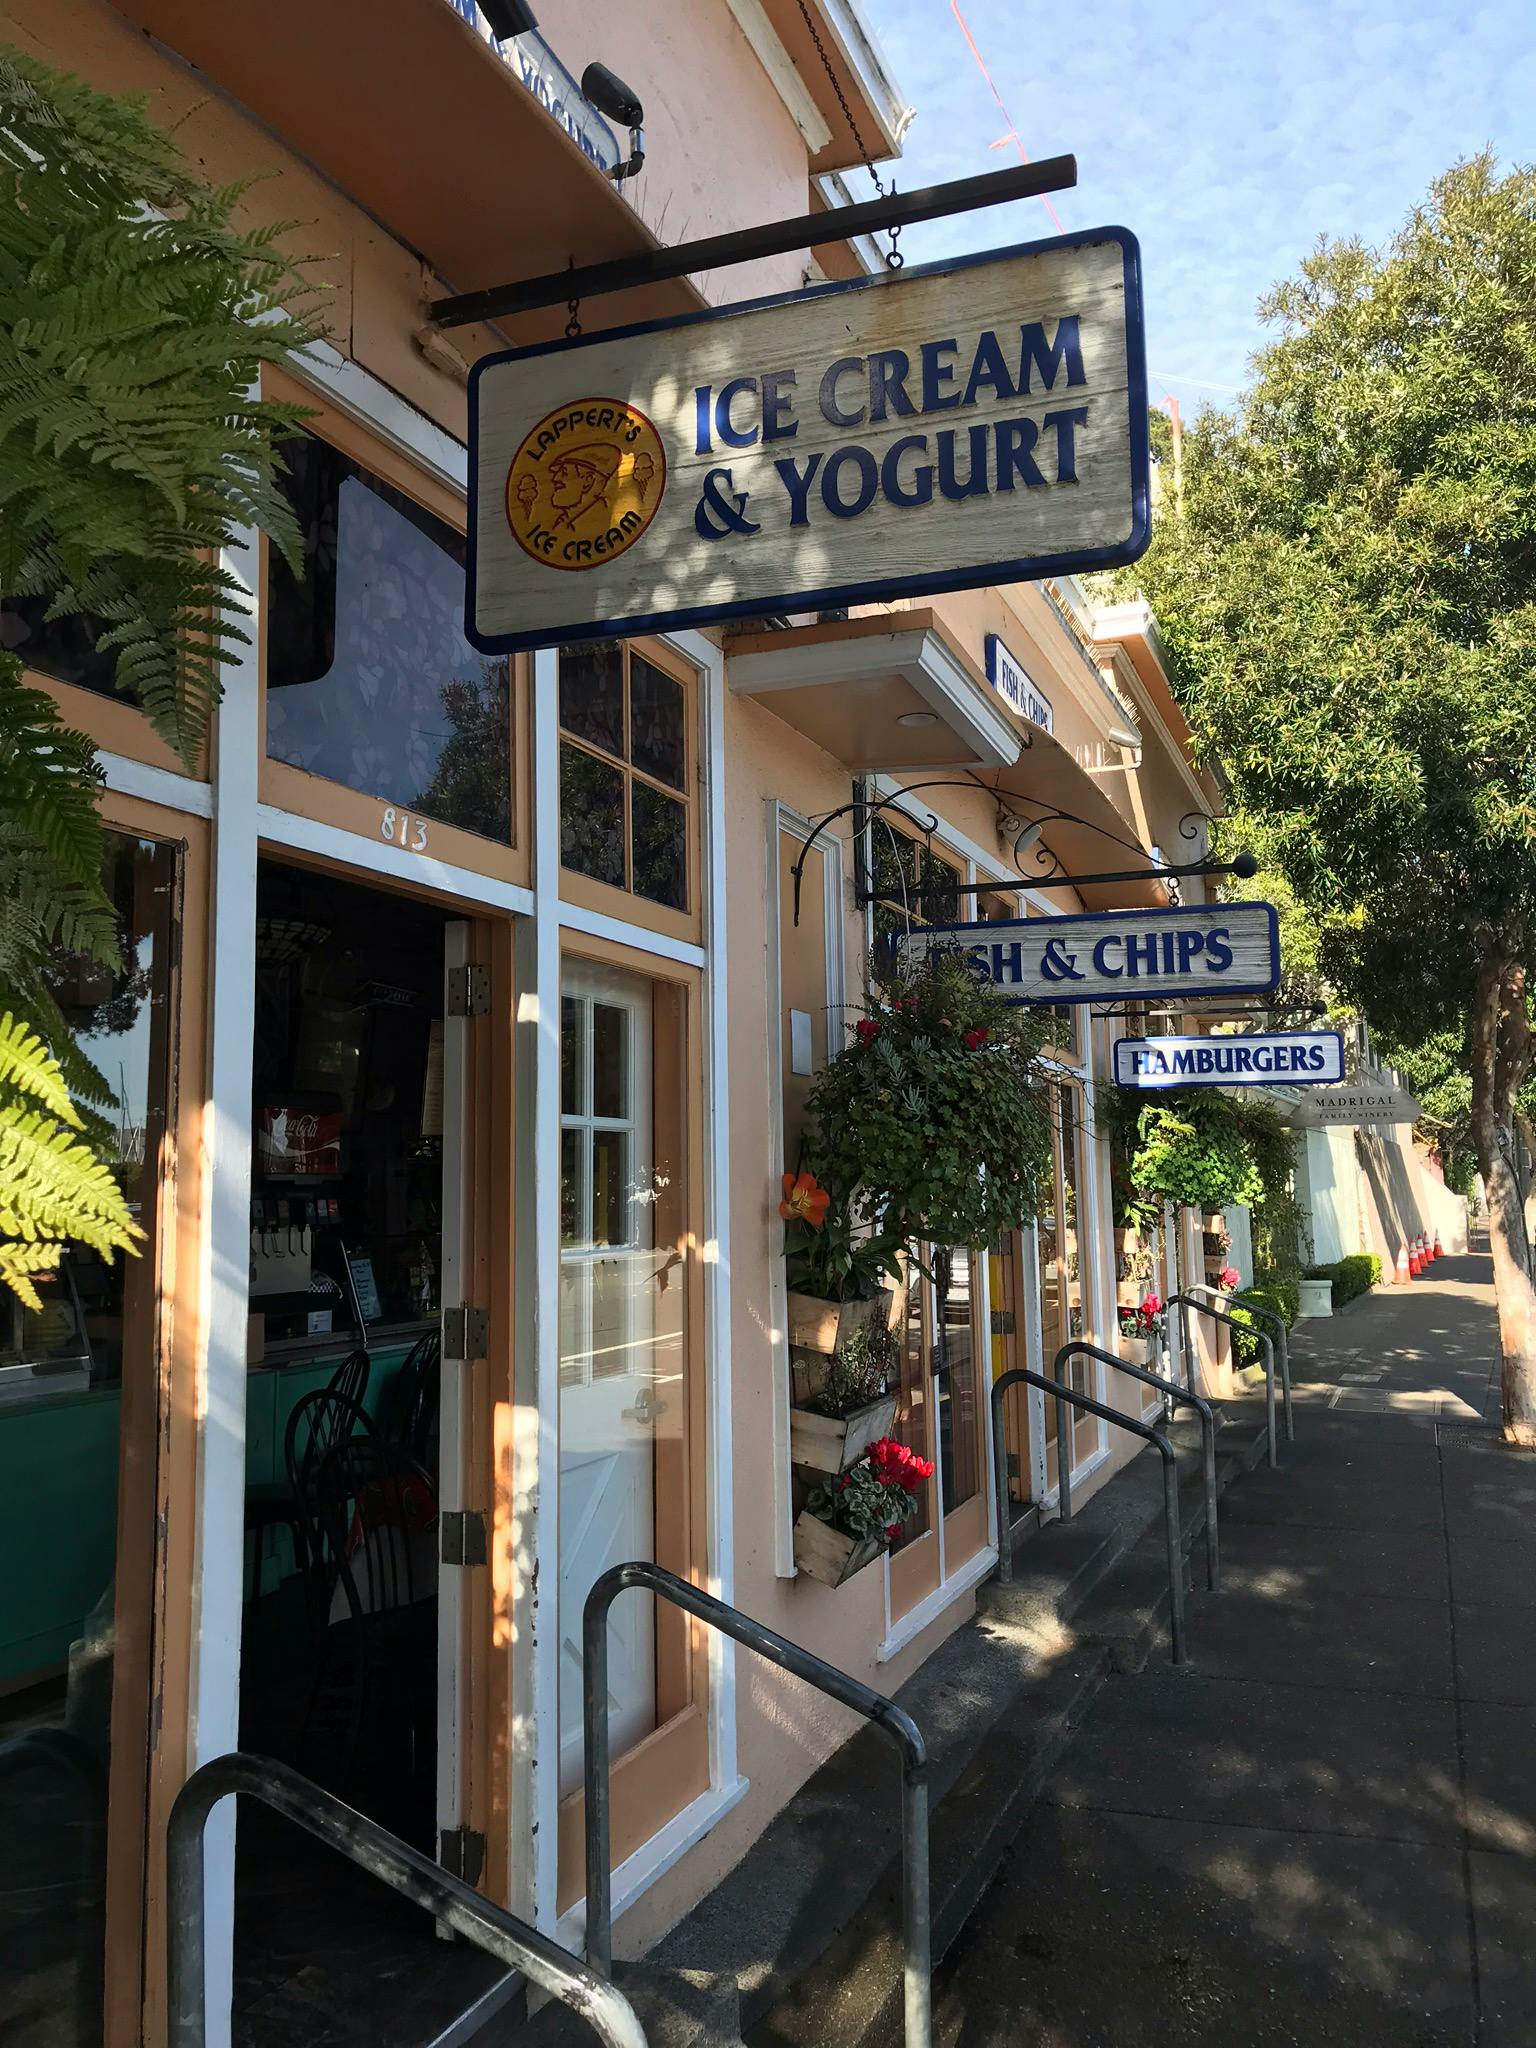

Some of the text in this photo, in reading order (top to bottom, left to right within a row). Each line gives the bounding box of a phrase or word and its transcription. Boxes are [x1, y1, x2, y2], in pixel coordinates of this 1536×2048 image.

[695, 314, 1088, 455] ICE CREAM
[526, 408, 641, 461] LAPPERT'S
[694, 406, 1090, 540] & YOGURT
[526, 510, 642, 560] ICE CREAM
[1002, 659, 1019, 705] FISH
[1020, 682, 1027, 717] &
[381, 807, 427, 851] 813
[1041, 937, 1086, 982] &
[1093, 928, 1234, 979] CHIPS
[1131, 1045, 1326, 1075] HAMBURGERS
[1316, 1096, 1396, 1107] MADRIGAL
